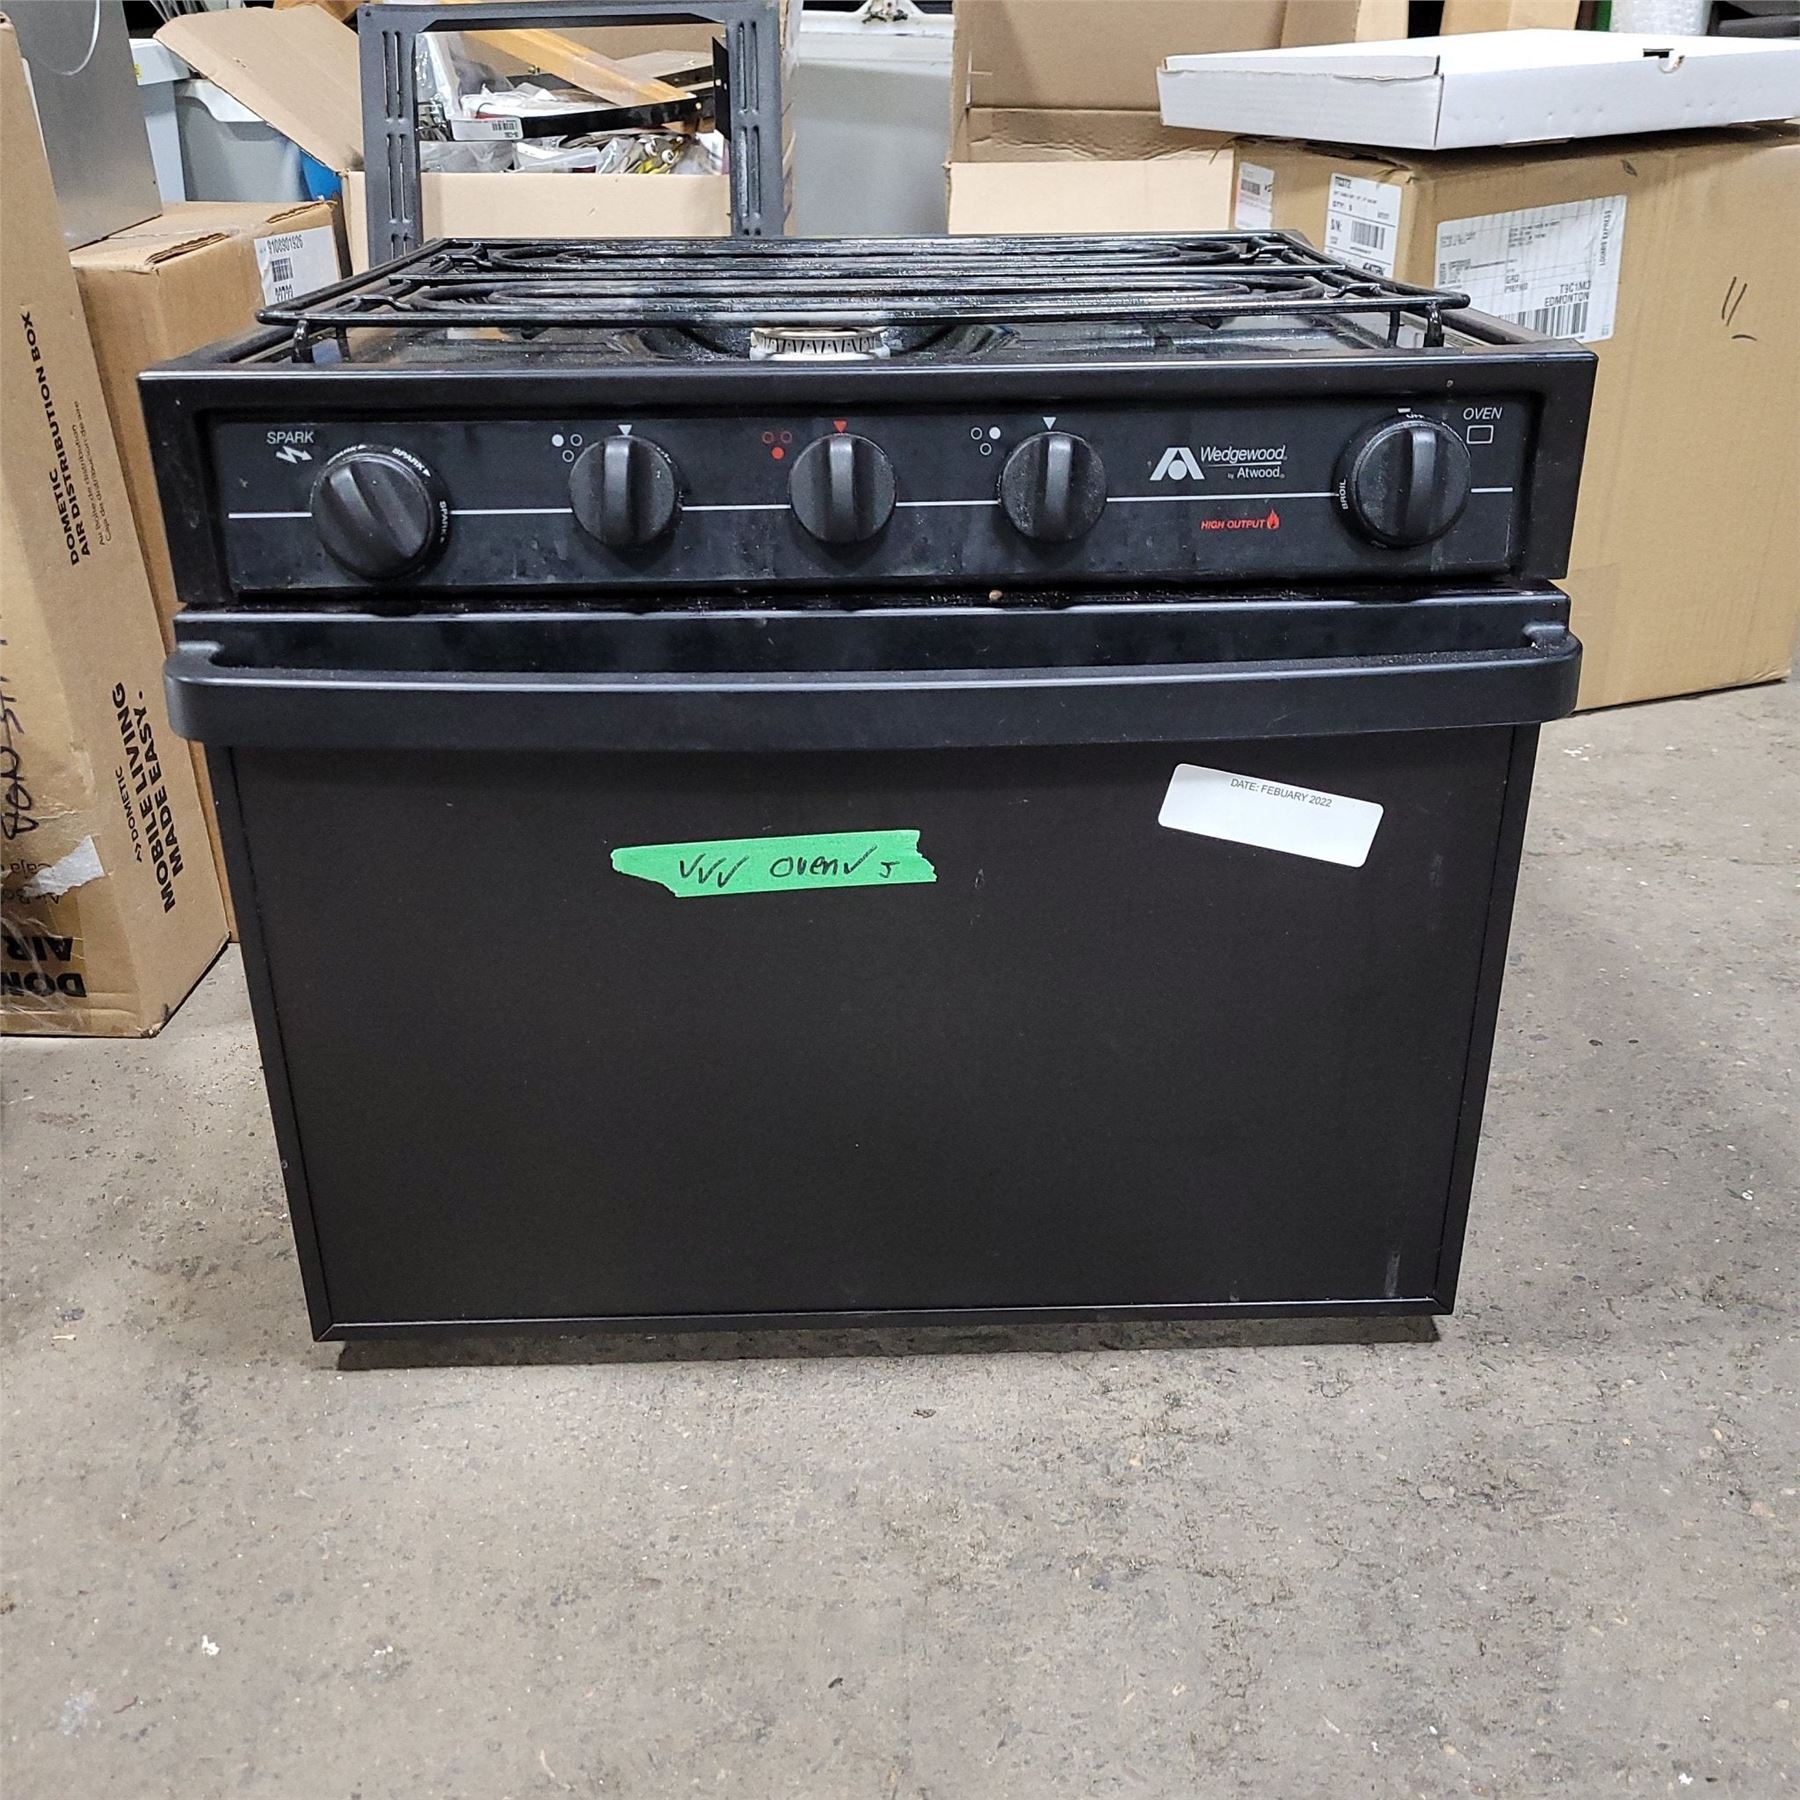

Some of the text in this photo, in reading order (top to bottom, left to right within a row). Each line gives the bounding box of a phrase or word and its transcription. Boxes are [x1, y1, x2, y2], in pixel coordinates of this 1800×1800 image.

[1544, 291, 1589, 307] EDMONTON
[1462, 407, 1503, 420] OVEN
[20, 311, 91, 556] AIR DISTRIBUTION BOX
[266, 431, 314, 444] SPARK
[392, 447, 425, 471] SPARK
[1339, 478, 1349, 510] BROIL
[49, 467, 80, 566] DOMETIC
[1201, 519, 1266, 530] HIGH OUTPUT
[112, 682, 176, 913] MOBILE LIVING
[115, 766, 139, 842] DOMETIC
[1230, 778, 1333, 808] DATE: FEBUARY 2022
[154, 785, 184, 877] MADE
